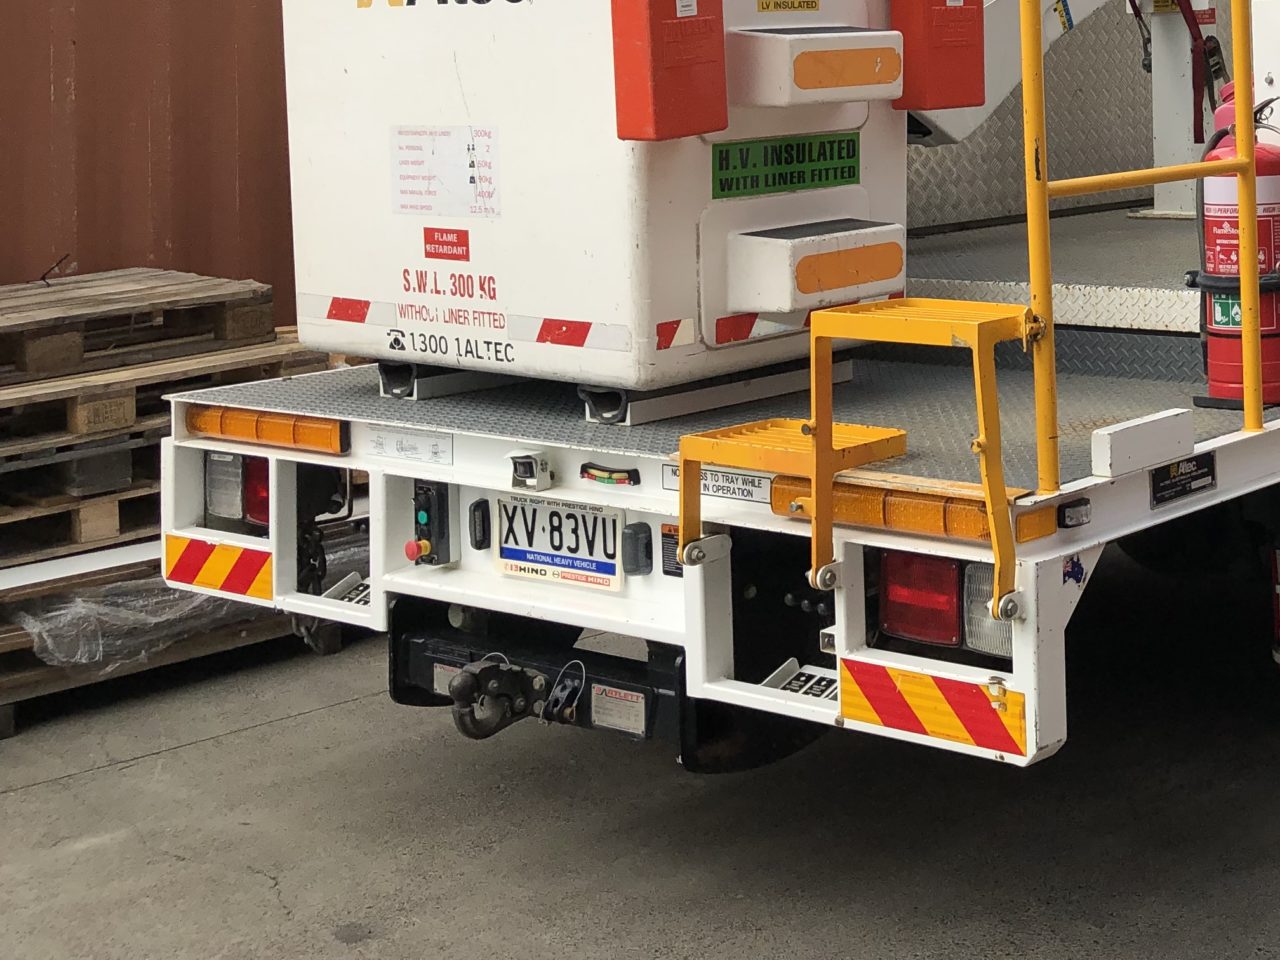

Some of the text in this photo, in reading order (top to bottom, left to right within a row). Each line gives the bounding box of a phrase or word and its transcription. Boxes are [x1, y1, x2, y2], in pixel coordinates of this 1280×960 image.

[762, 1, 818, 10] LV INSULATED
[718, 138, 857, 172] H.V. INSULATED
[719, 165, 857, 192] WITH LINER FITTED
[434, 232, 458, 242] FLAME
[426, 244, 467, 256] RETARDANT
[450, 273, 475, 298] 300
[479, 275, 497, 300] KG
[443, 309, 471, 326] LINER
[473, 310, 506, 329] FITTED
[410, 332, 515, 363] 1300 1ALTEC
[1178, 460, 1197, 476] Altec
[711, 473, 720, 483] TO
[721, 474, 739, 486] TRAY
[741, 477, 762, 488] WHILE
[702, 483, 754, 499] IN OPERATION
[561, 503, 588, 511] PRESTIGE
[526, 553, 597, 570] NATIONAL HEAVY VEHICLE
[561, 572, 587, 581] PRESTIGE
[587, 575, 610, 585] HINO
